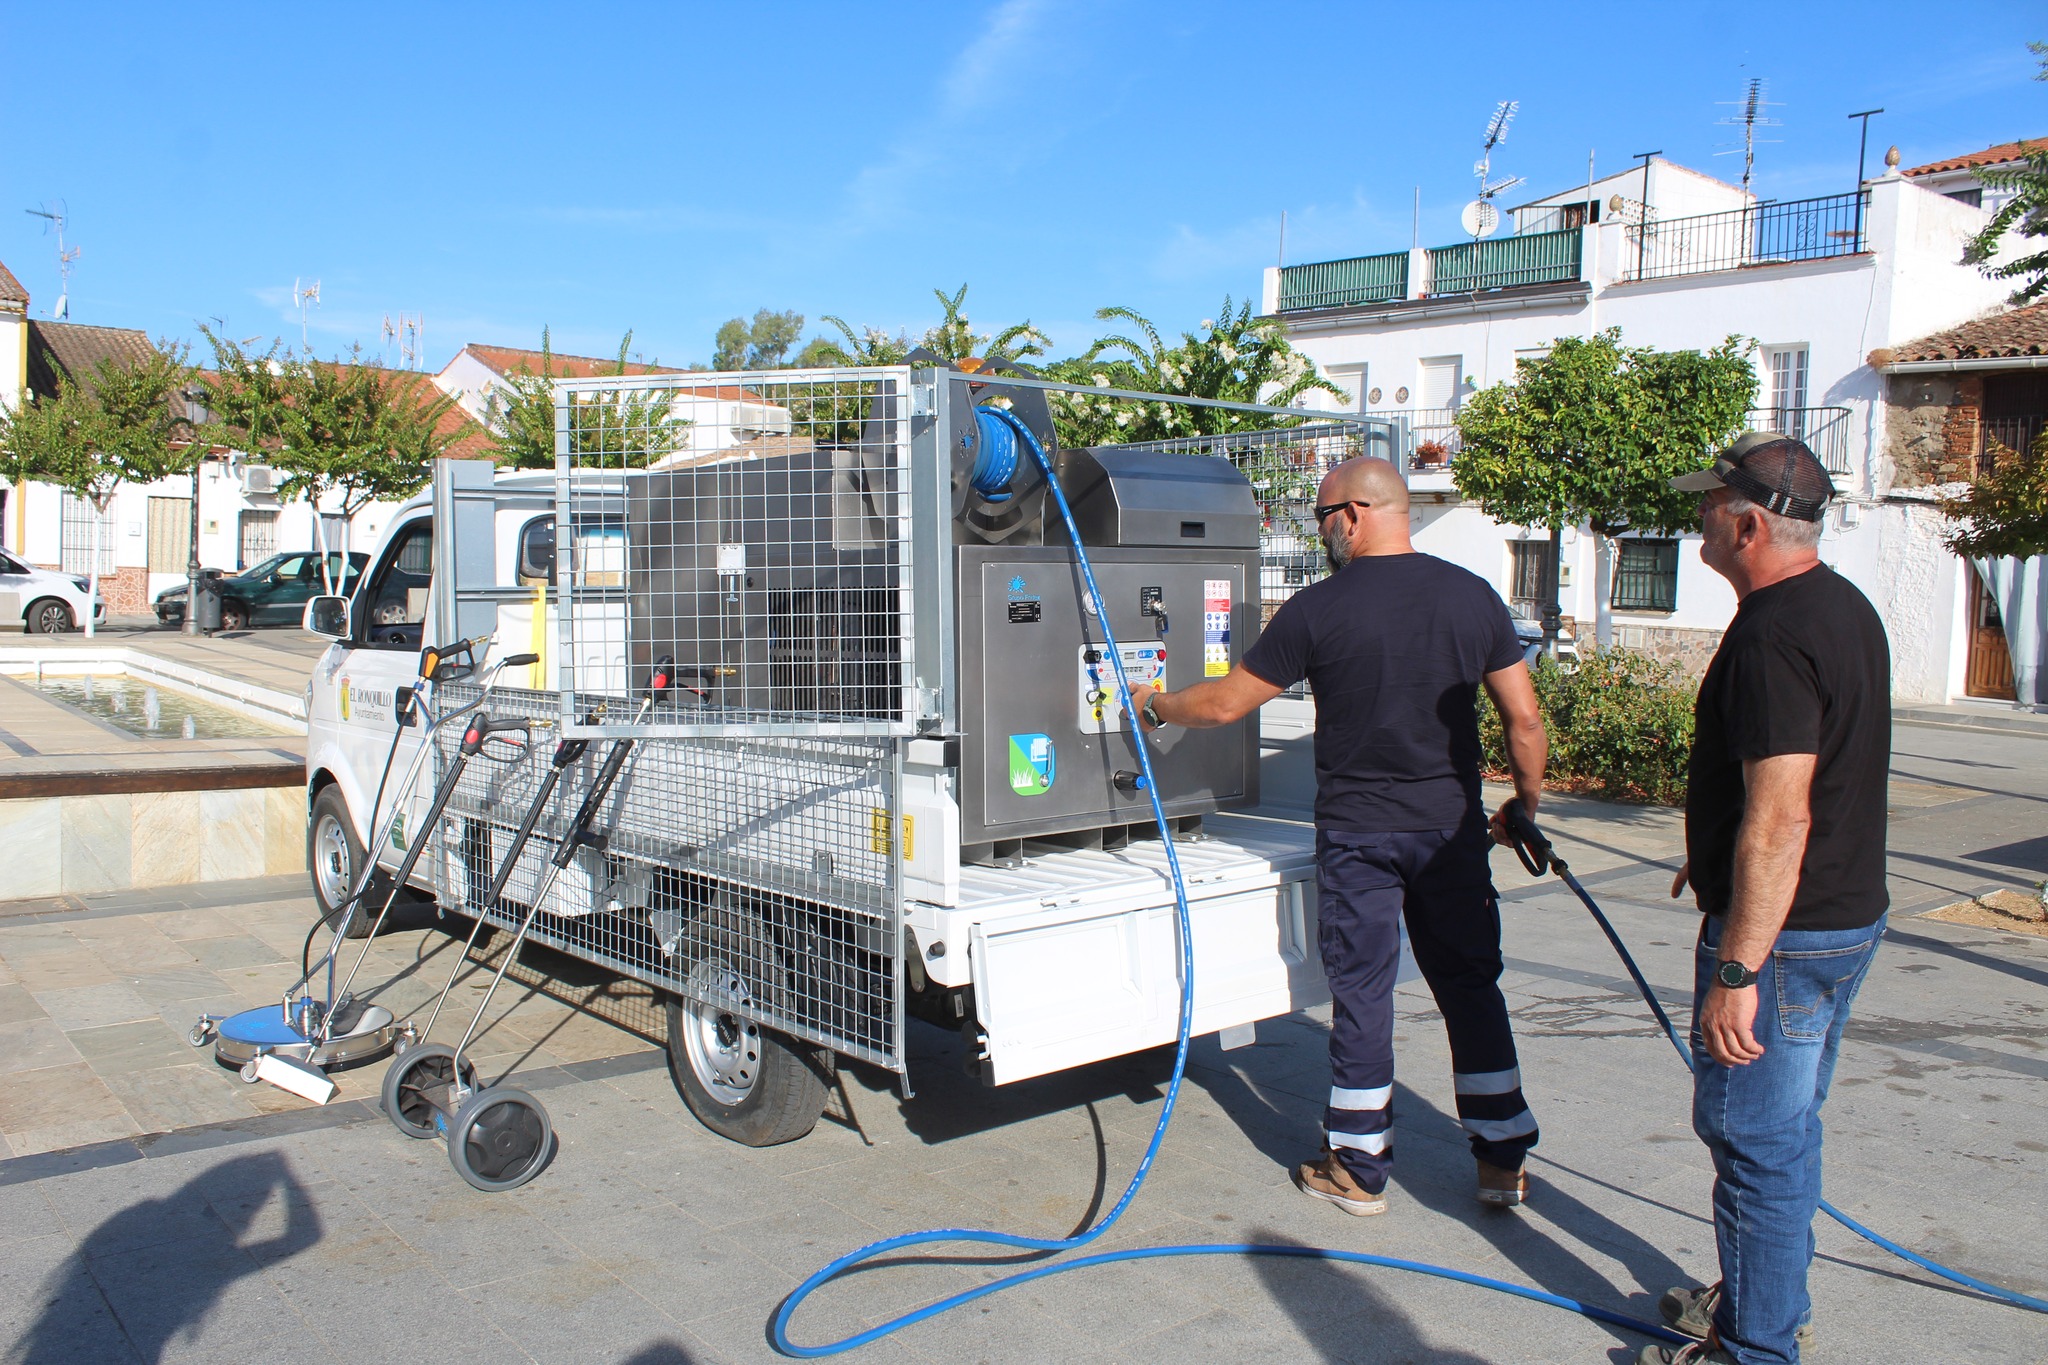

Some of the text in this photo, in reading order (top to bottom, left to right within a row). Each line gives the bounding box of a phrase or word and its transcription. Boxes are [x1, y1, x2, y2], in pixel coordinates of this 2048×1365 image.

[350, 688, 391, 708] EL RONQUILLO
[355, 706, 384, 721] Ayuntamiento
